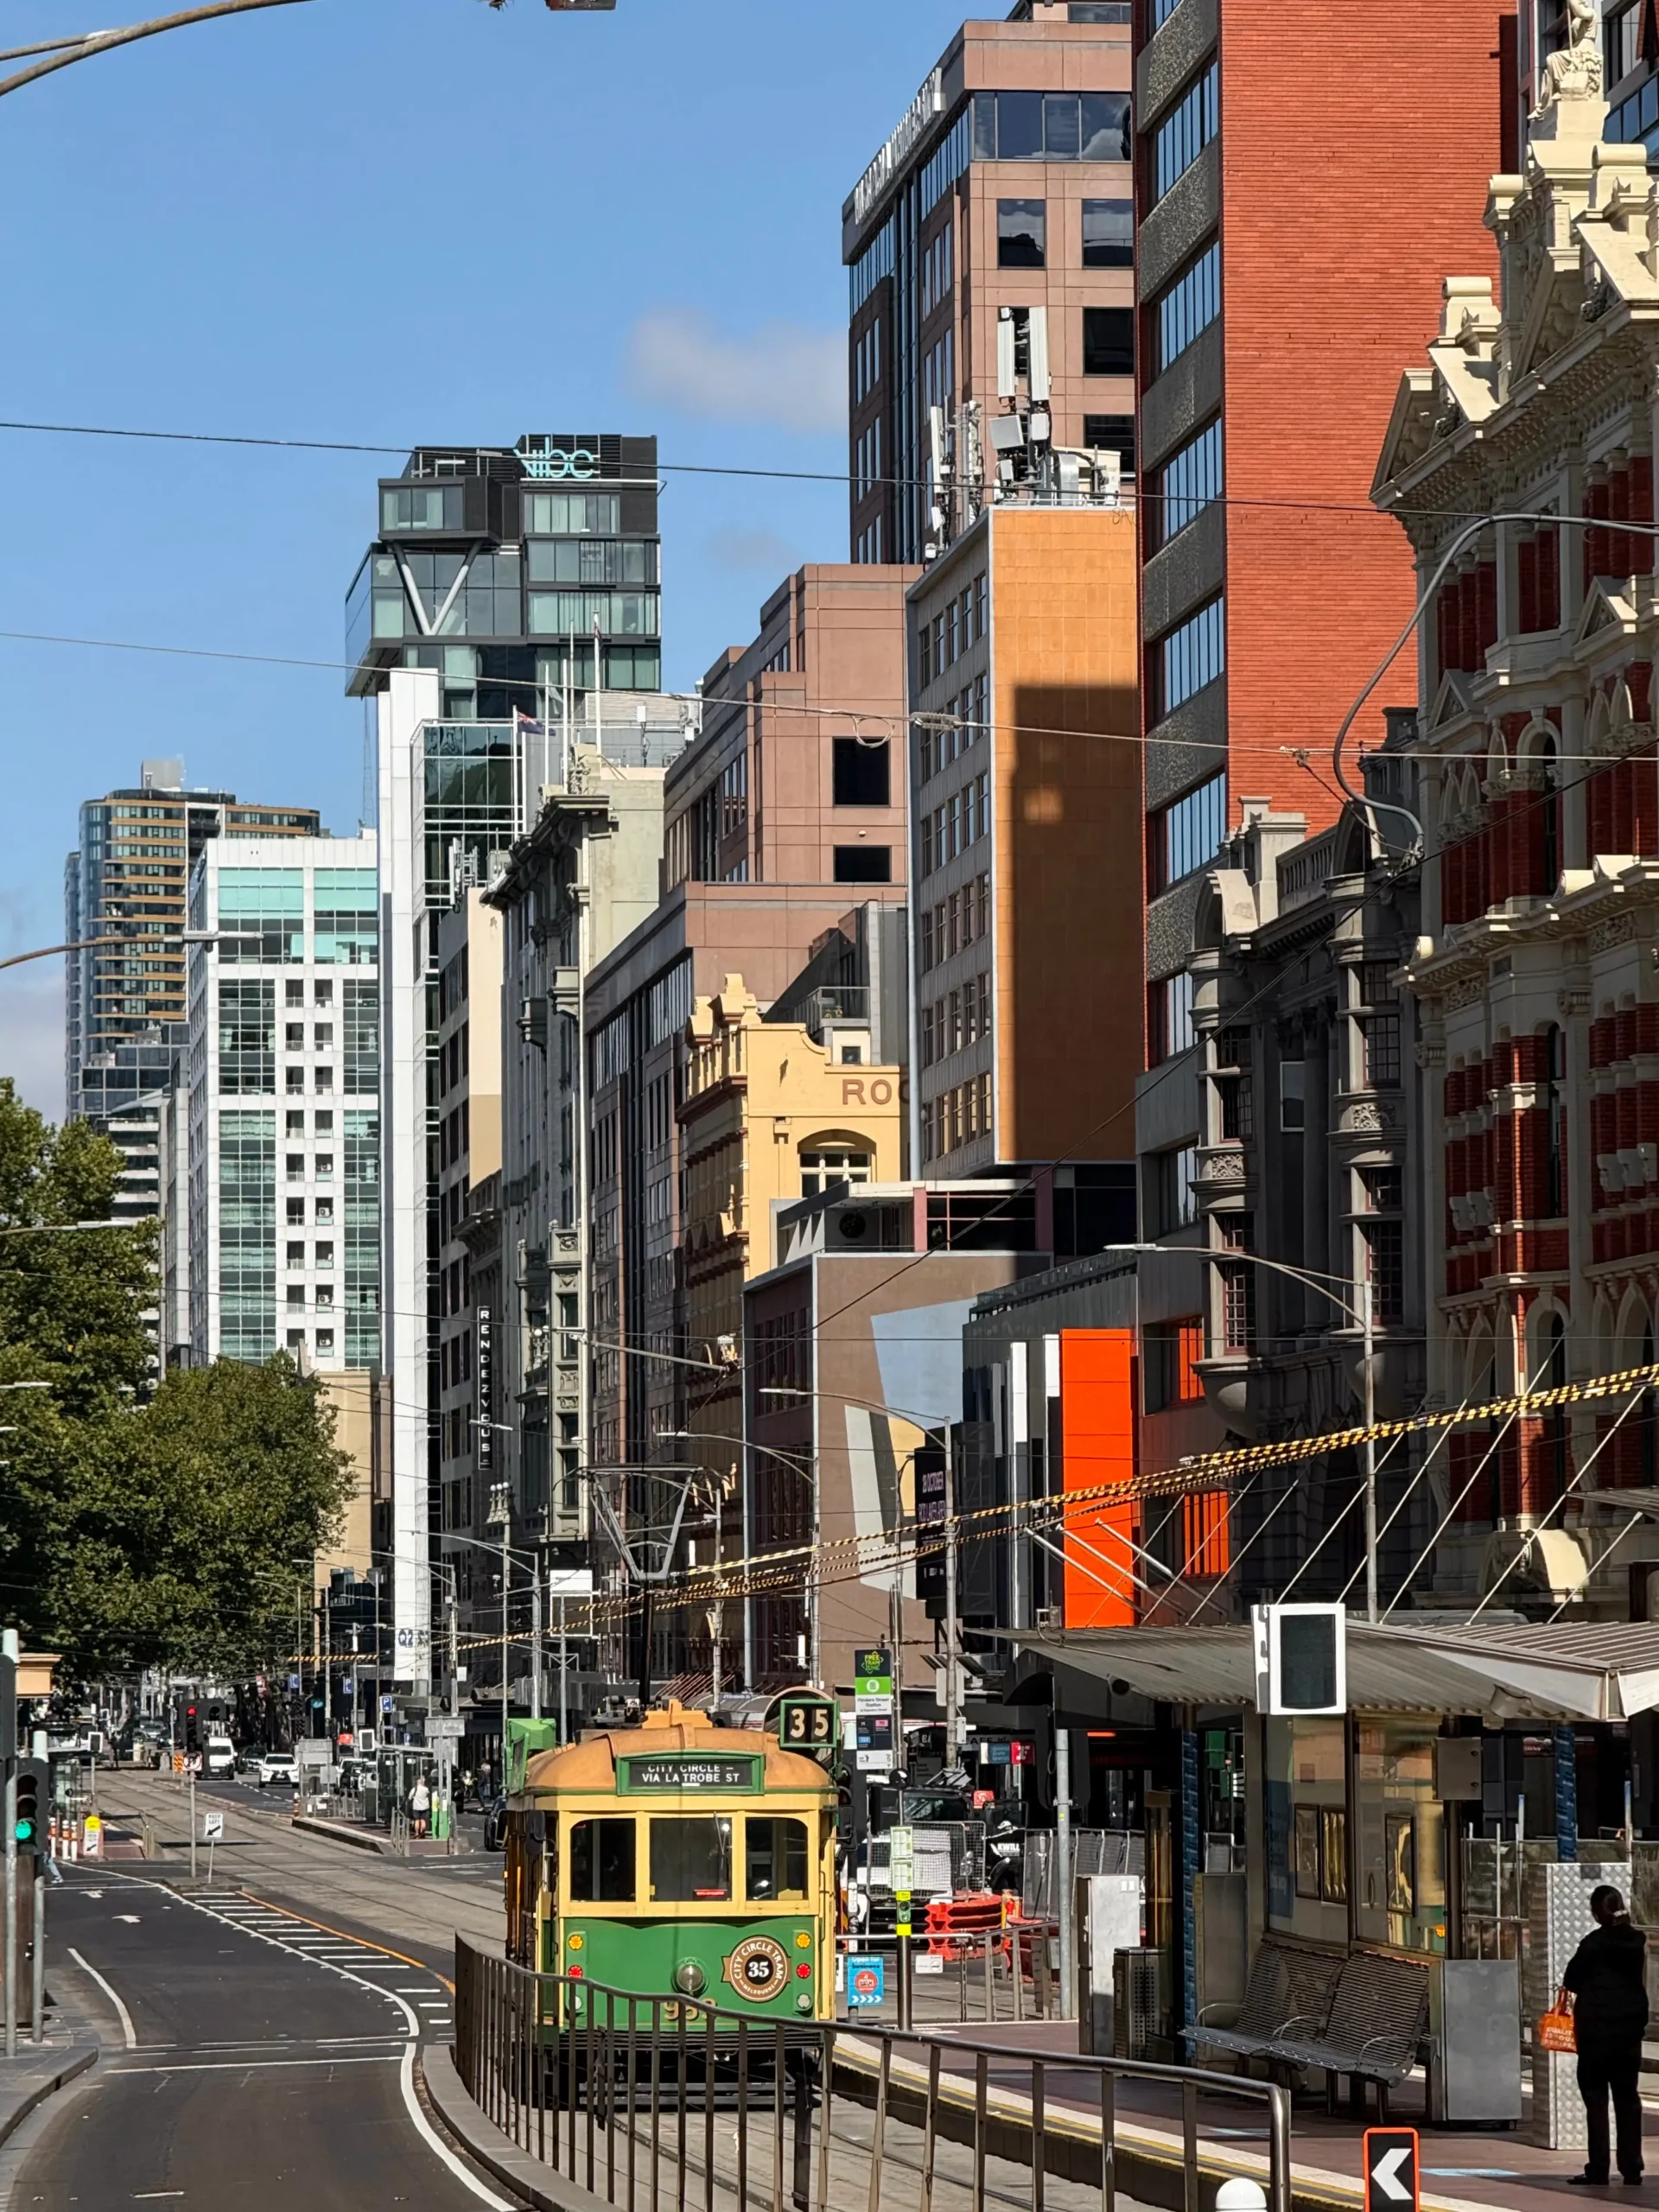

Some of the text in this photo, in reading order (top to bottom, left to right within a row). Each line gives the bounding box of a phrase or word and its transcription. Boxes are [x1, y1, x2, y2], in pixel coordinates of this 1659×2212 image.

[480, 1310, 491, 1452] RENDEZVOUS
[790, 1707, 829, 1738] 35
[648, 1764, 721, 1773] CITY CIRCLE
[642, 1773, 740, 1783] VIA LA TROBE ST
[734, 1942, 784, 1980] CITY CIRCLE TRAM
[748, 1961, 769, 1978] 35
[743, 1984, 775, 1995] MELBOURNE
